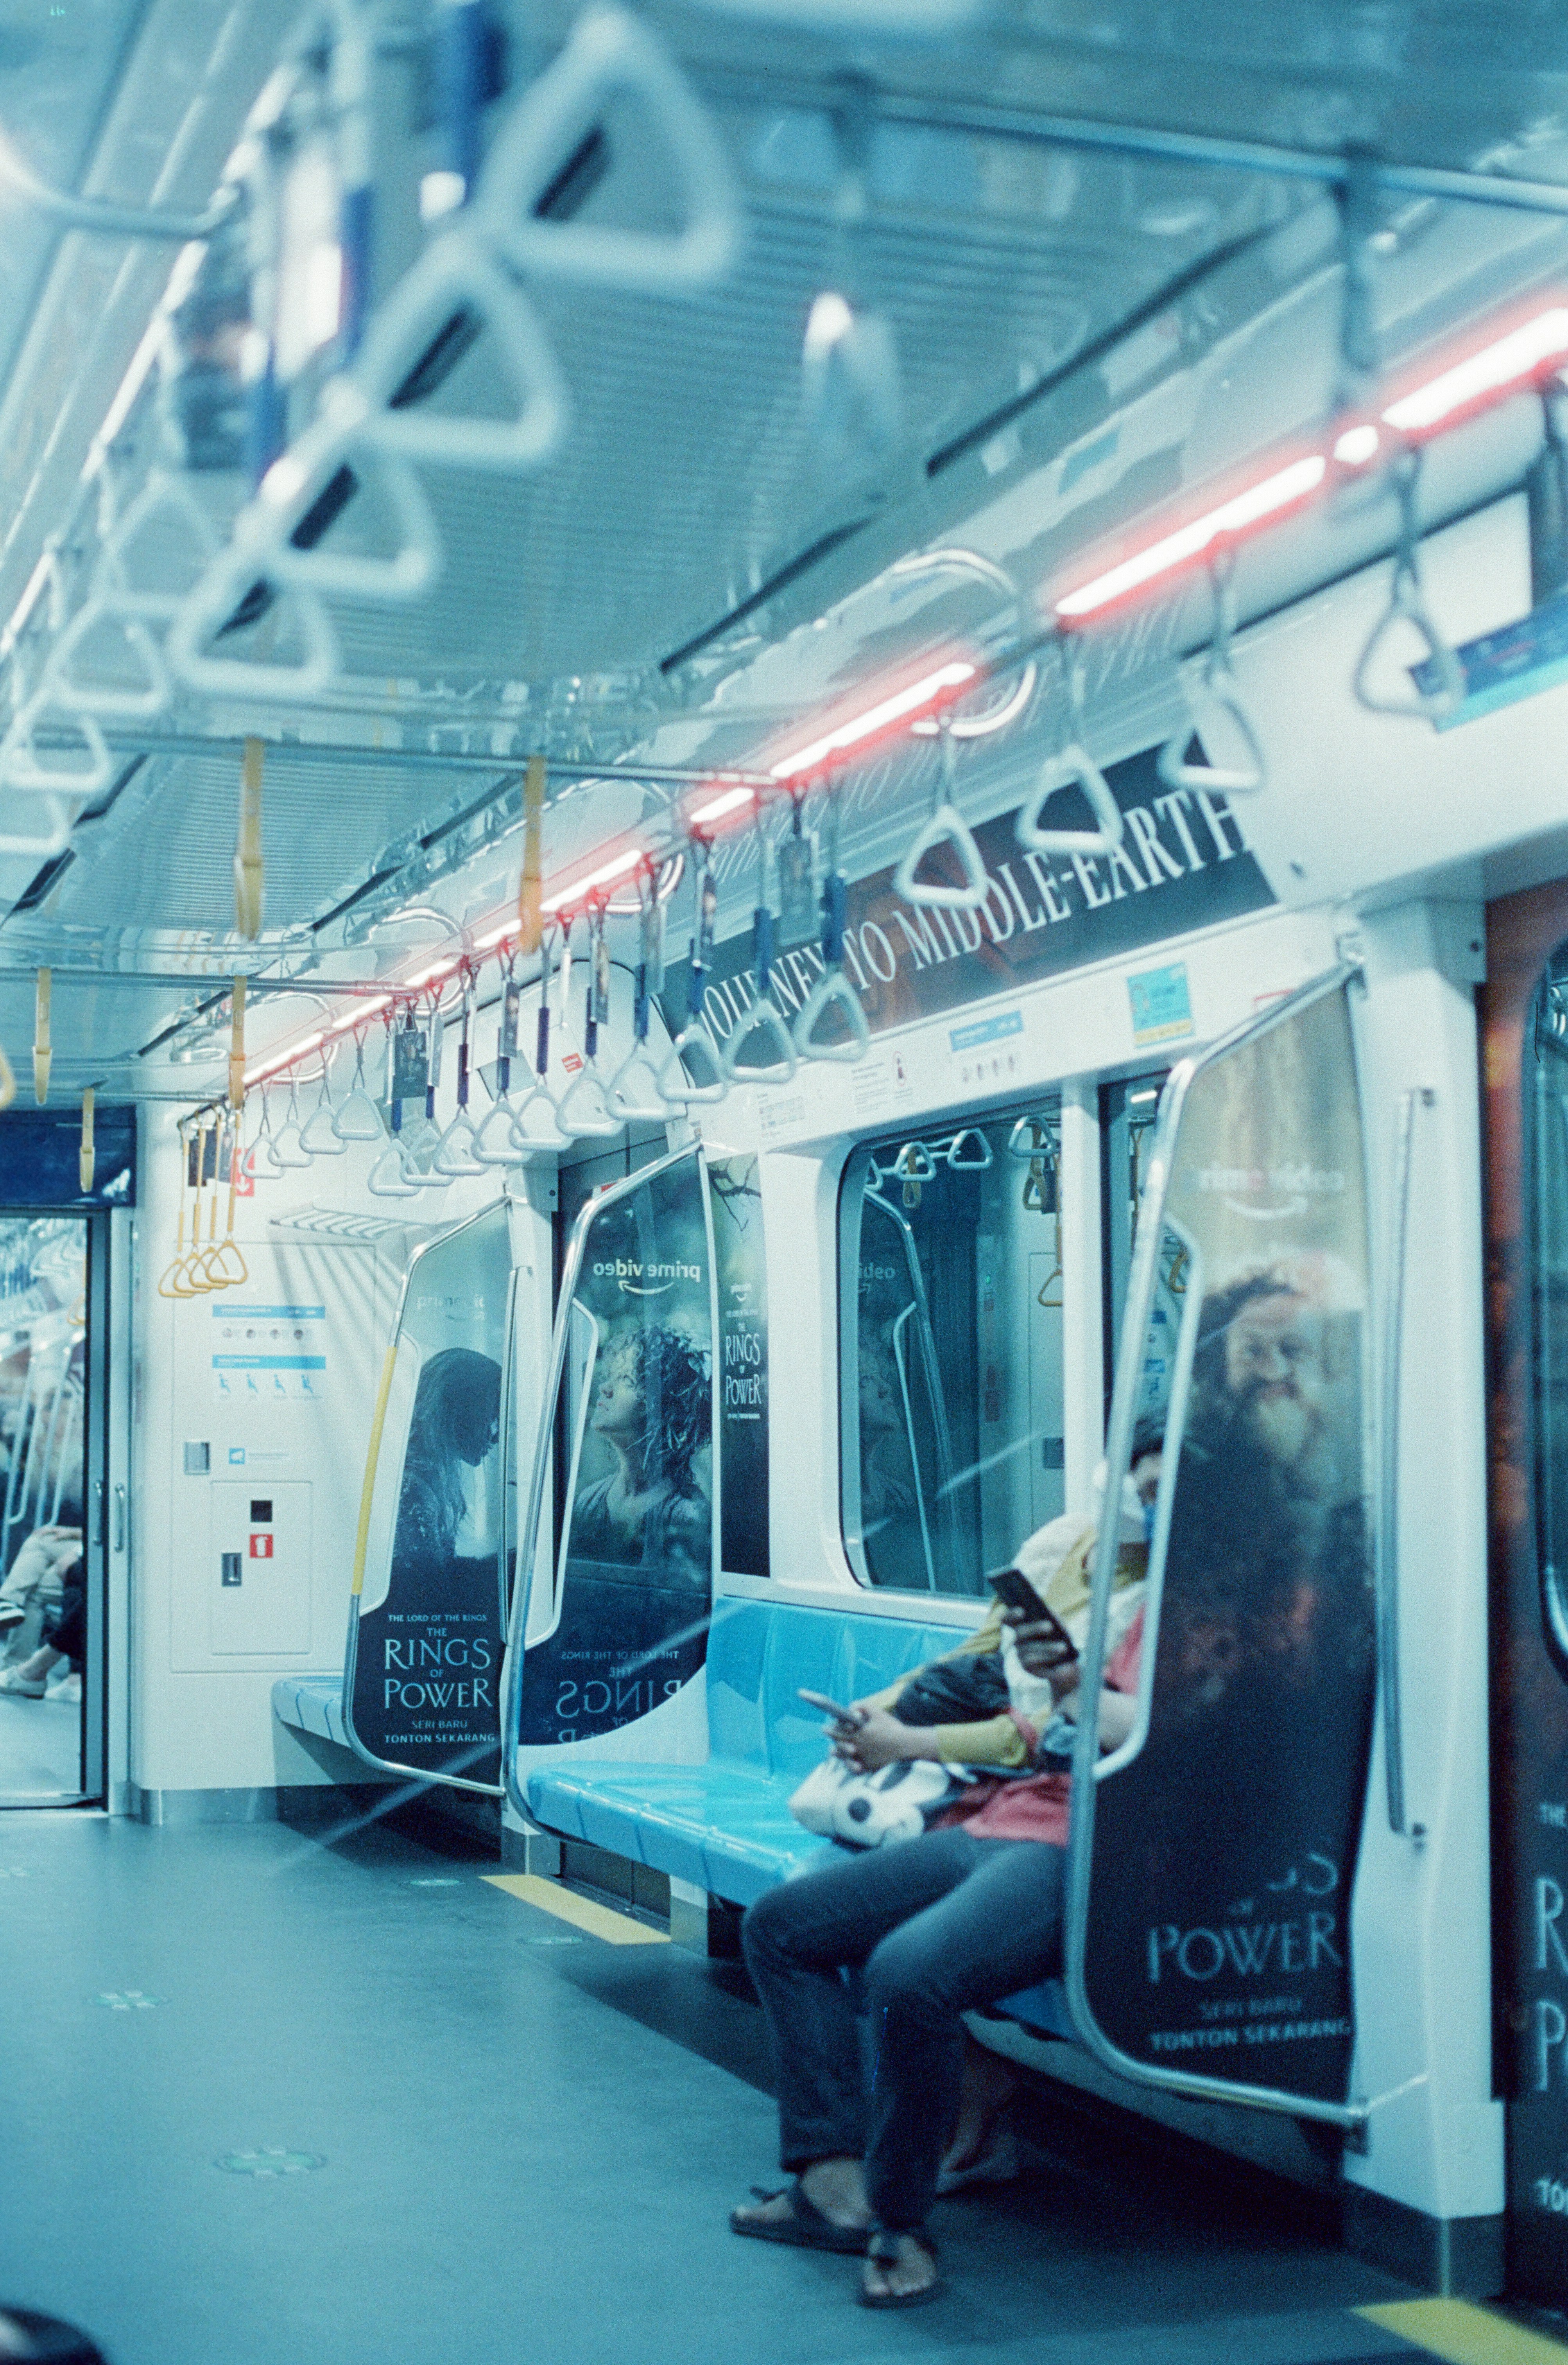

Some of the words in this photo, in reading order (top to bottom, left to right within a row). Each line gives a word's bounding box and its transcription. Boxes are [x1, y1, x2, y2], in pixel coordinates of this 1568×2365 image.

[842, 921, 896, 990] TO
[892, 788, 1253, 971] MIDDLE-EARTH
[859, 1261, 895, 1279] ideo
[726, 1333, 760, 1366] RINGS
[726, 1374, 762, 1405] POWER
[426, 1627, 448, 1637] THE
[385, 1638, 491, 1670] RINGS
[430, 1669, 444, 1678] OF
[385, 1678, 493, 1709] POWER
[385, 1734, 432, 1743] TONTON
[435, 1733, 495, 1742] SEKARANG
[412, 1720, 435, 1729] SERI
[439, 1720, 468, 1728] BARU
[1148, 1911, 1344, 1984] POWER
